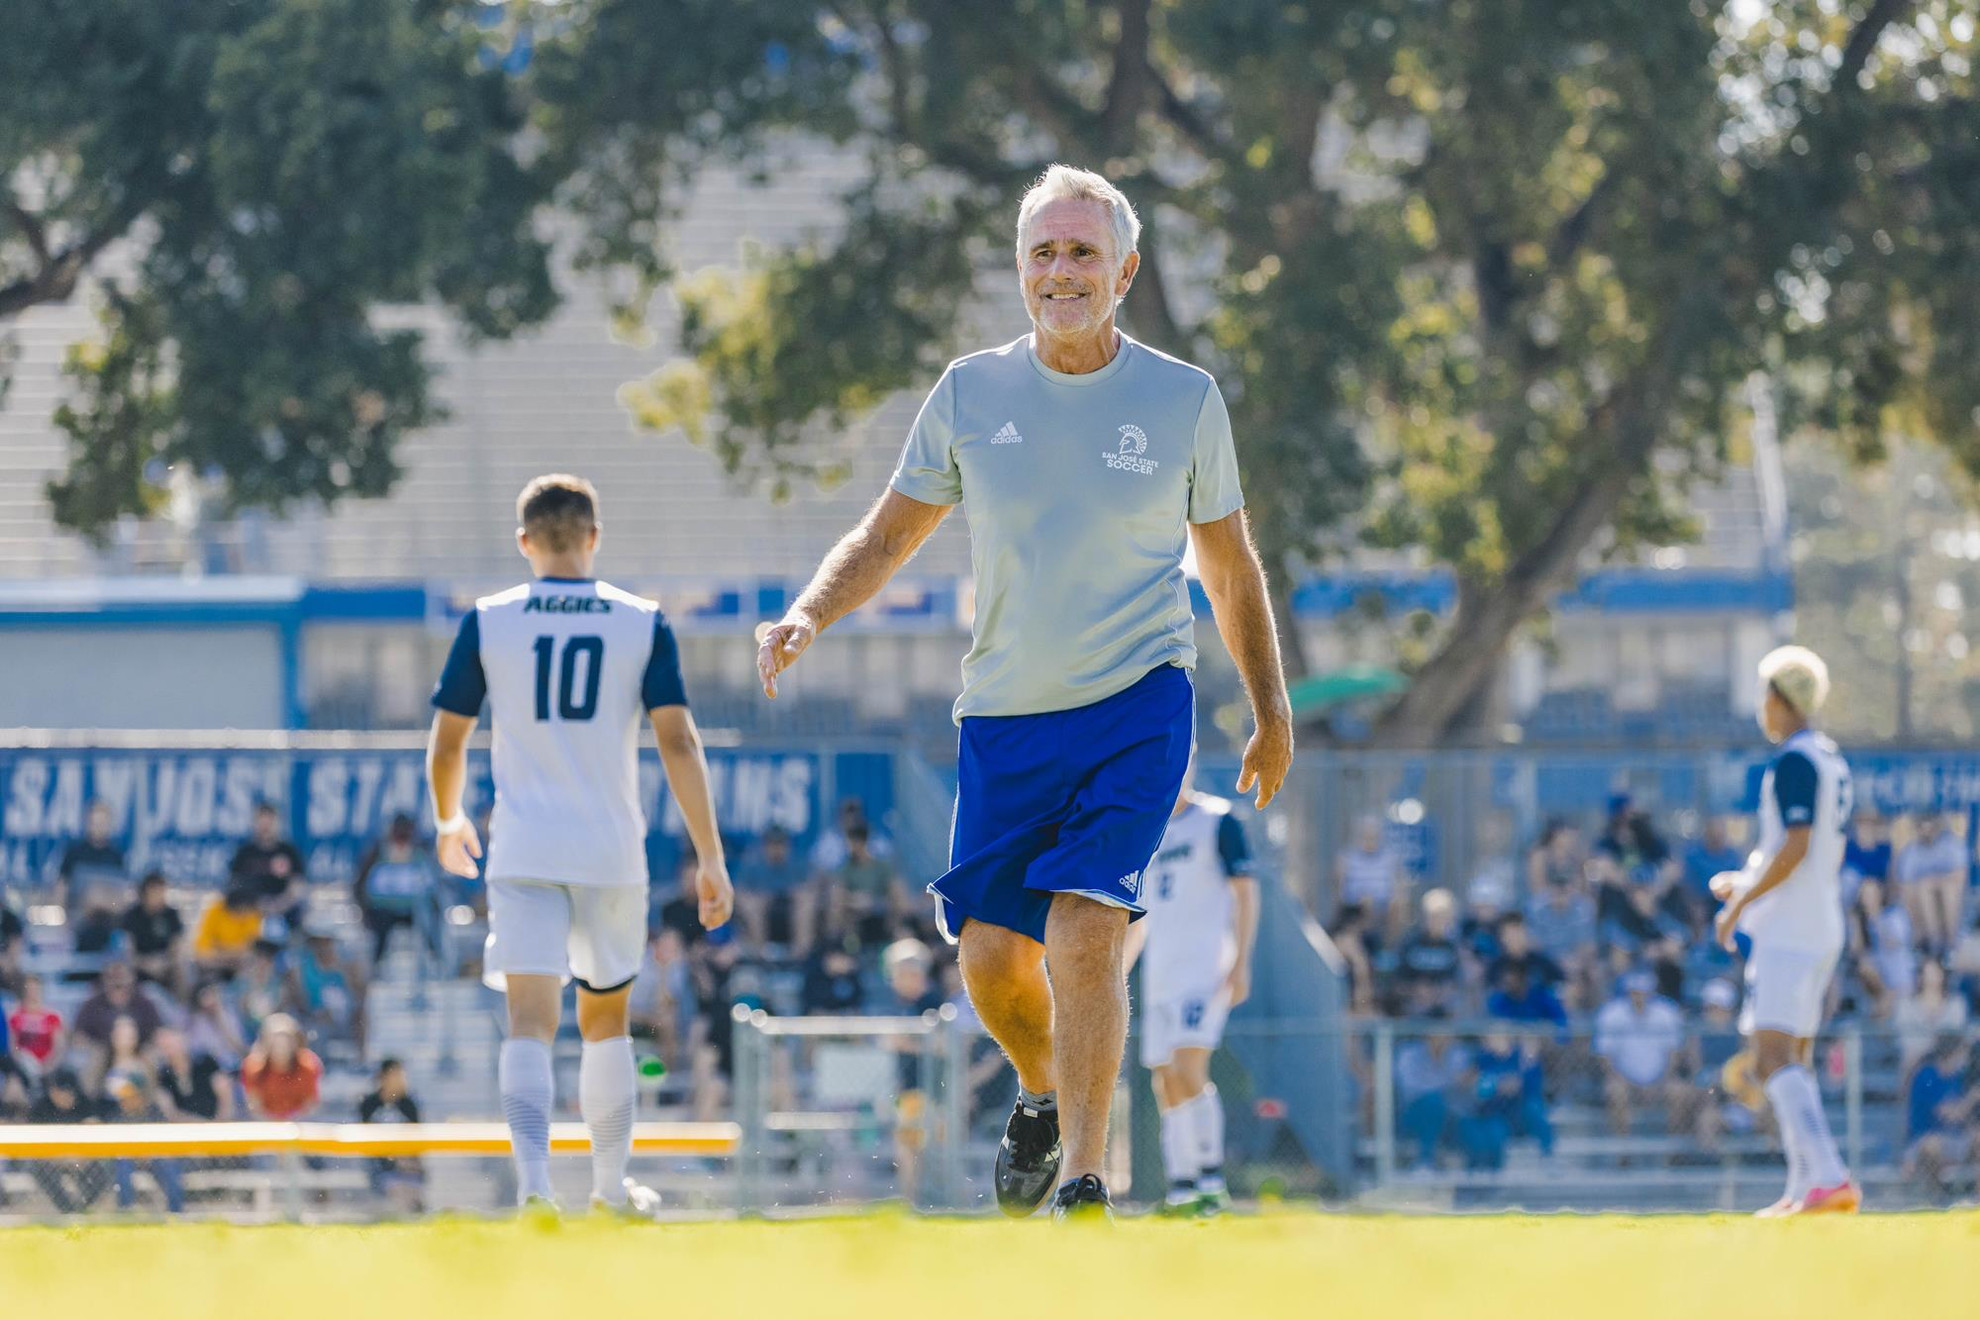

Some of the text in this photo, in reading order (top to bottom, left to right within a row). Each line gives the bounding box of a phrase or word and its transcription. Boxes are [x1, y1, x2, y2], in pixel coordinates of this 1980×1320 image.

[990, 435, 1022, 444] adidas
[1102, 451, 1117, 460] SAN
[1138, 457, 1159, 468] STATE
[1107, 459, 1153, 475] SOCCER
[523, 594, 613, 614] AGGIES
[533, 634, 604, 721] 10
